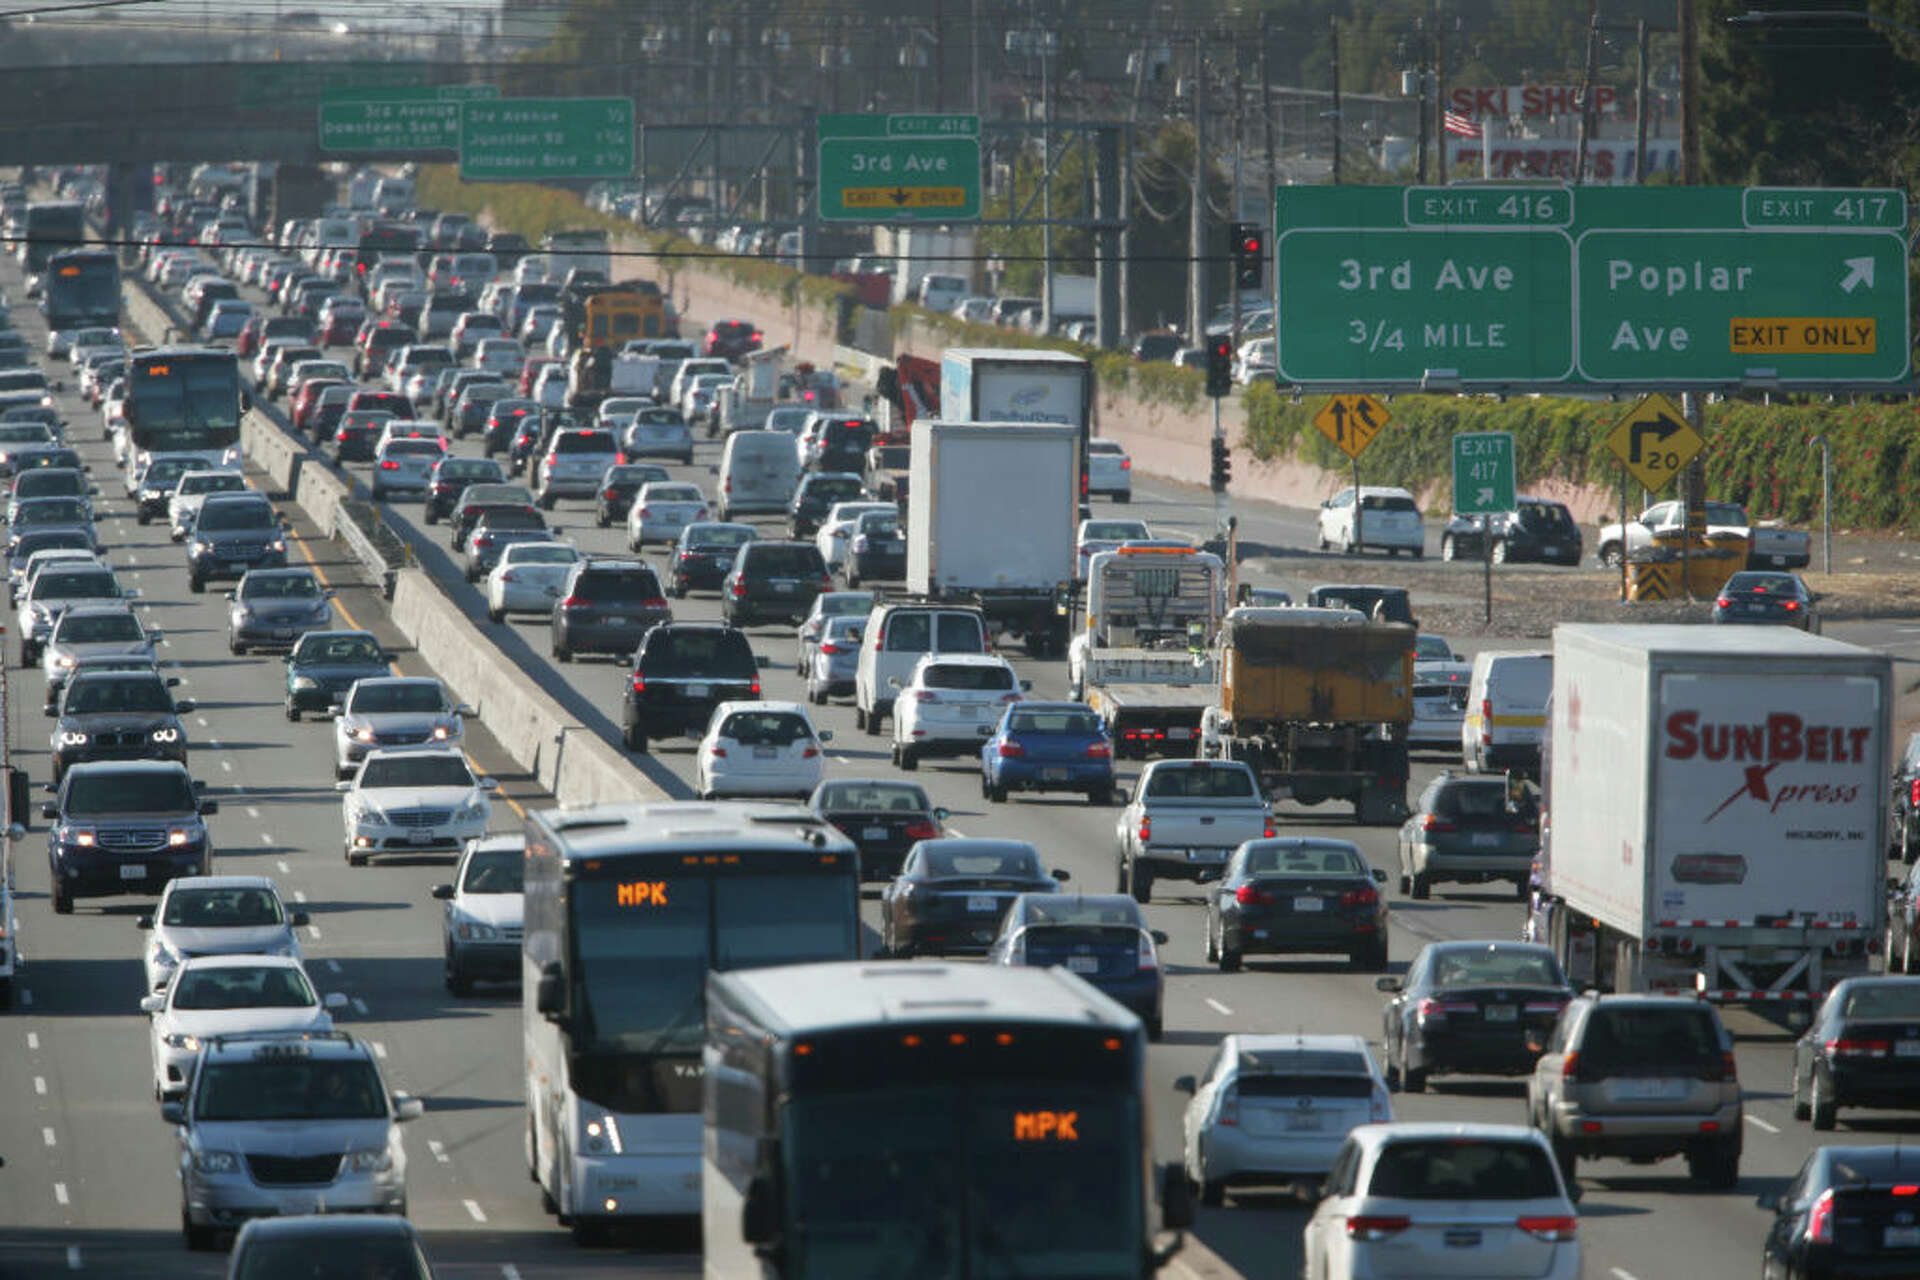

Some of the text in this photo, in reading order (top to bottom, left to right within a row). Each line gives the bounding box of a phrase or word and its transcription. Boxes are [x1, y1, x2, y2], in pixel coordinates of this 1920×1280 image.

[1452, 87, 1508, 117] SKI
[469, 109, 496, 123] 3rd
[503, 110, 559, 123] Avenue
[896, 119, 971, 131] EXIT 416
[852, 153, 948, 171] 3rd Ave
[1424, 196, 1554, 218] EXIT 416
[1761, 198, 1888, 220] EXIT 417
[1338, 259, 1514, 290] 3rd Ave
[1608, 260, 1753, 296] Poplar
[1349, 319, 1506, 352] 3/4 MILE
[1611, 320, 1690, 351] Ave
[1733, 325, 1873, 346] EXIT ONLY
[1460, 439, 1505, 457] EXIT
[1470, 461, 1498, 481] 417
[1647, 451, 1680, 470] 20
[1702, 761, 1862, 825] Xpress
[617, 881, 669, 906] MPK
[1014, 1110, 1079, 1141] MPK
